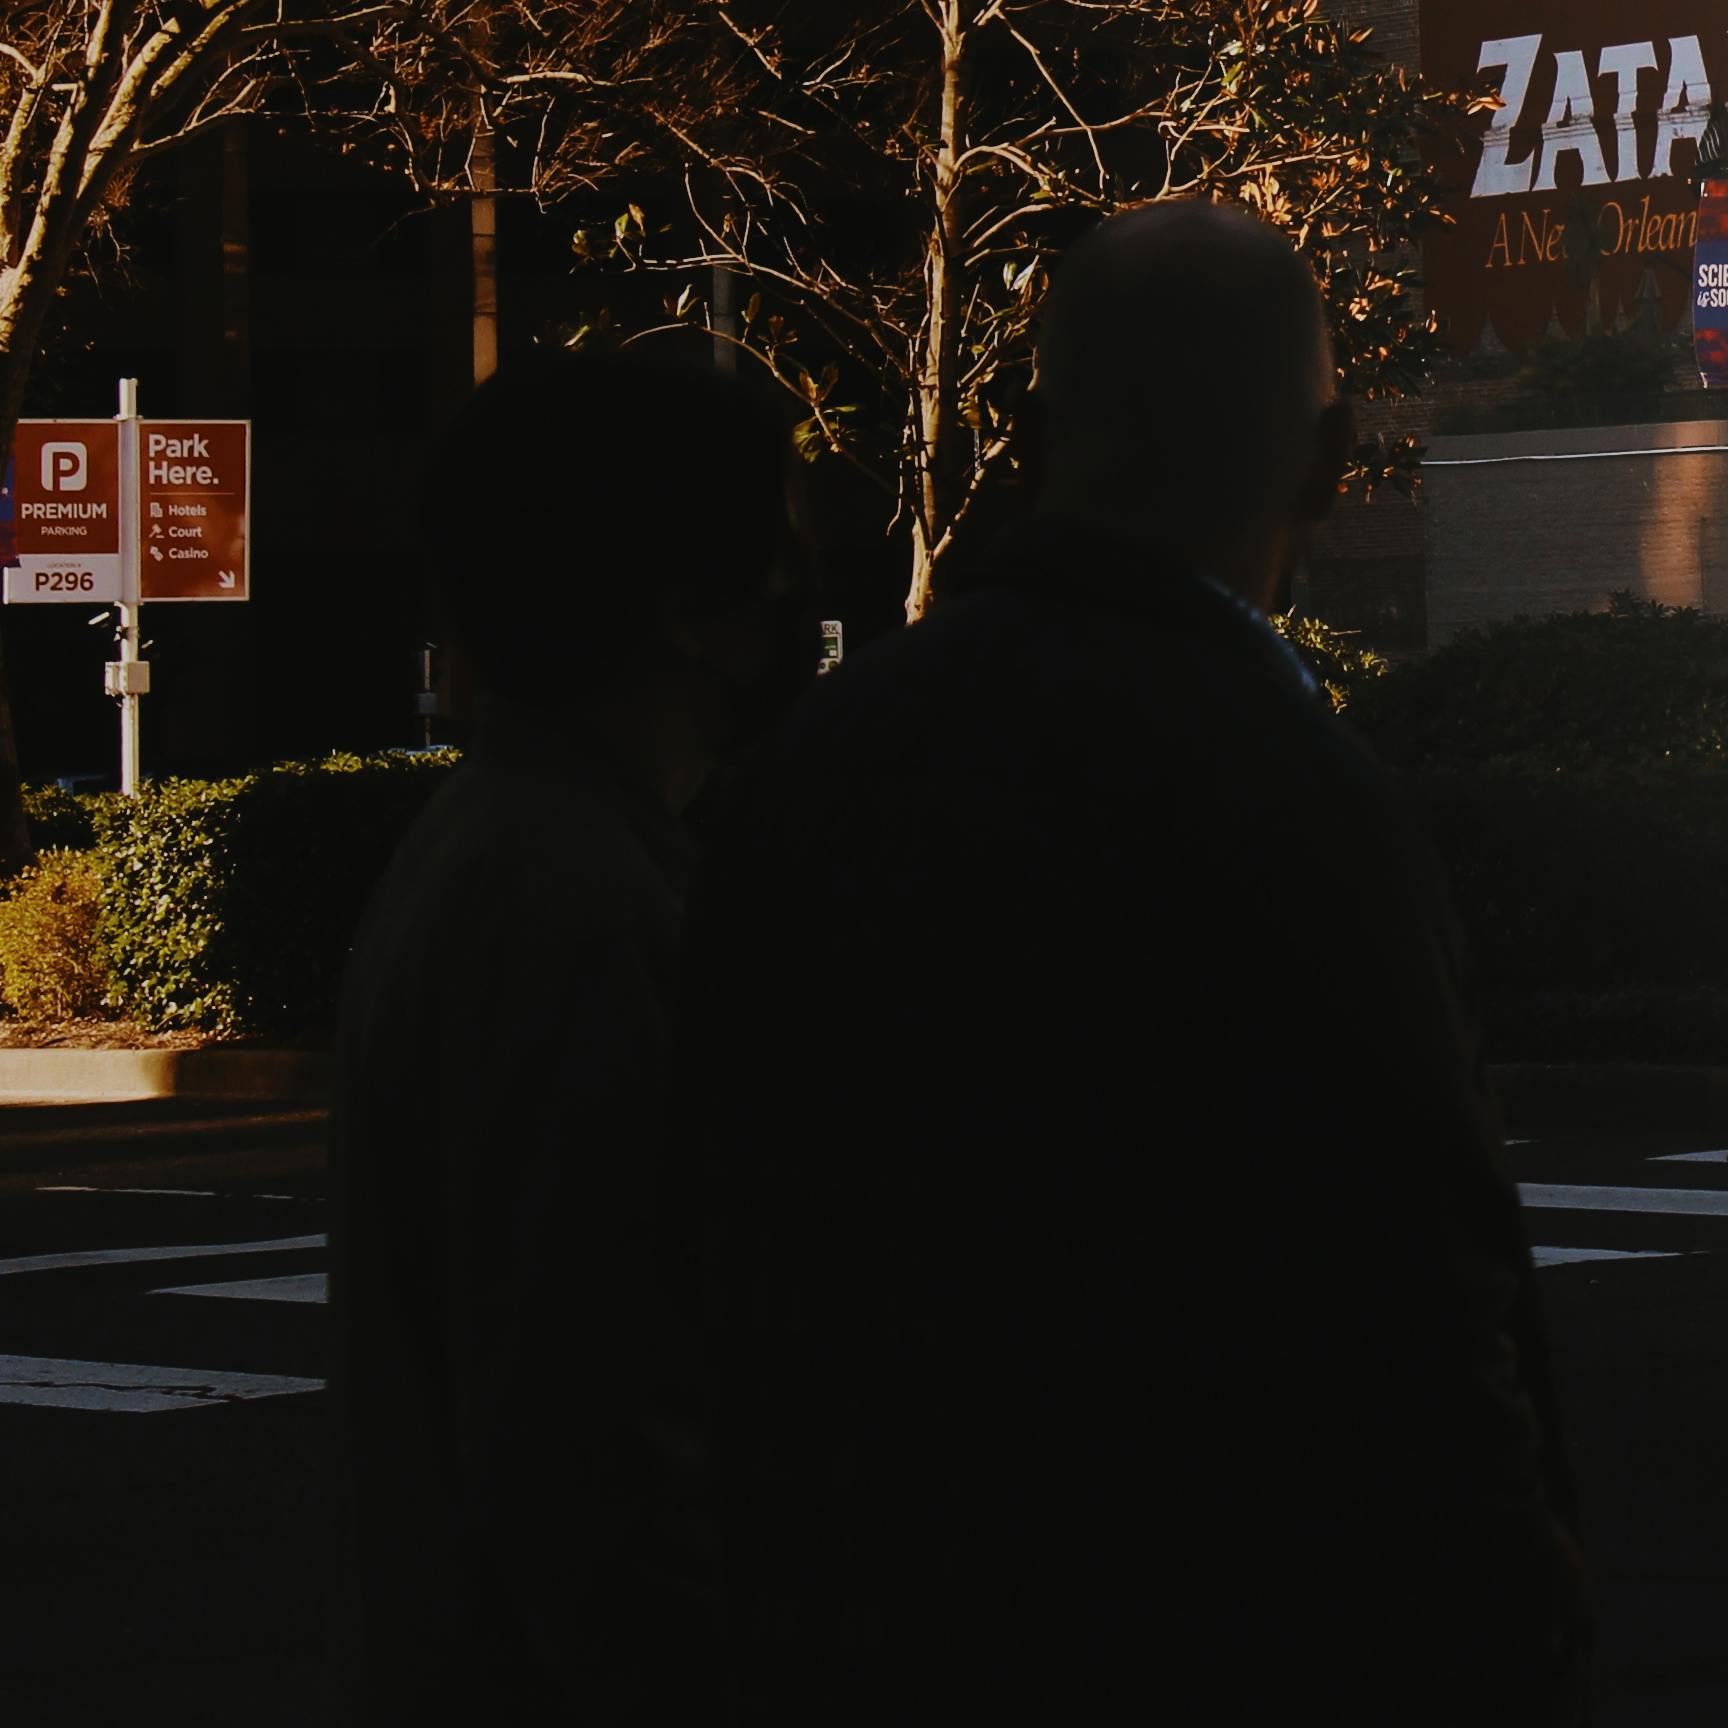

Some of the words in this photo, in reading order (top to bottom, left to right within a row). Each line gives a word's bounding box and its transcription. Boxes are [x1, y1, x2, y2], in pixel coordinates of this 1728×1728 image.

[1485, 211, 1513, 268] A
[1518, 208, 1568, 265] Ne
[1600, 195, 1698, 256] Orlean
[148, 433, 210, 458] Park
[148, 461, 220, 485] Here.
[21, 503, 107, 520] PREMIUM
[168, 504, 207, 517] Hotels
[41, 526, 88, 536] PARKING
[168, 526, 203, 538] Court
[168, 548, 209, 559] Casino
[35, 572, 94, 592] P296
